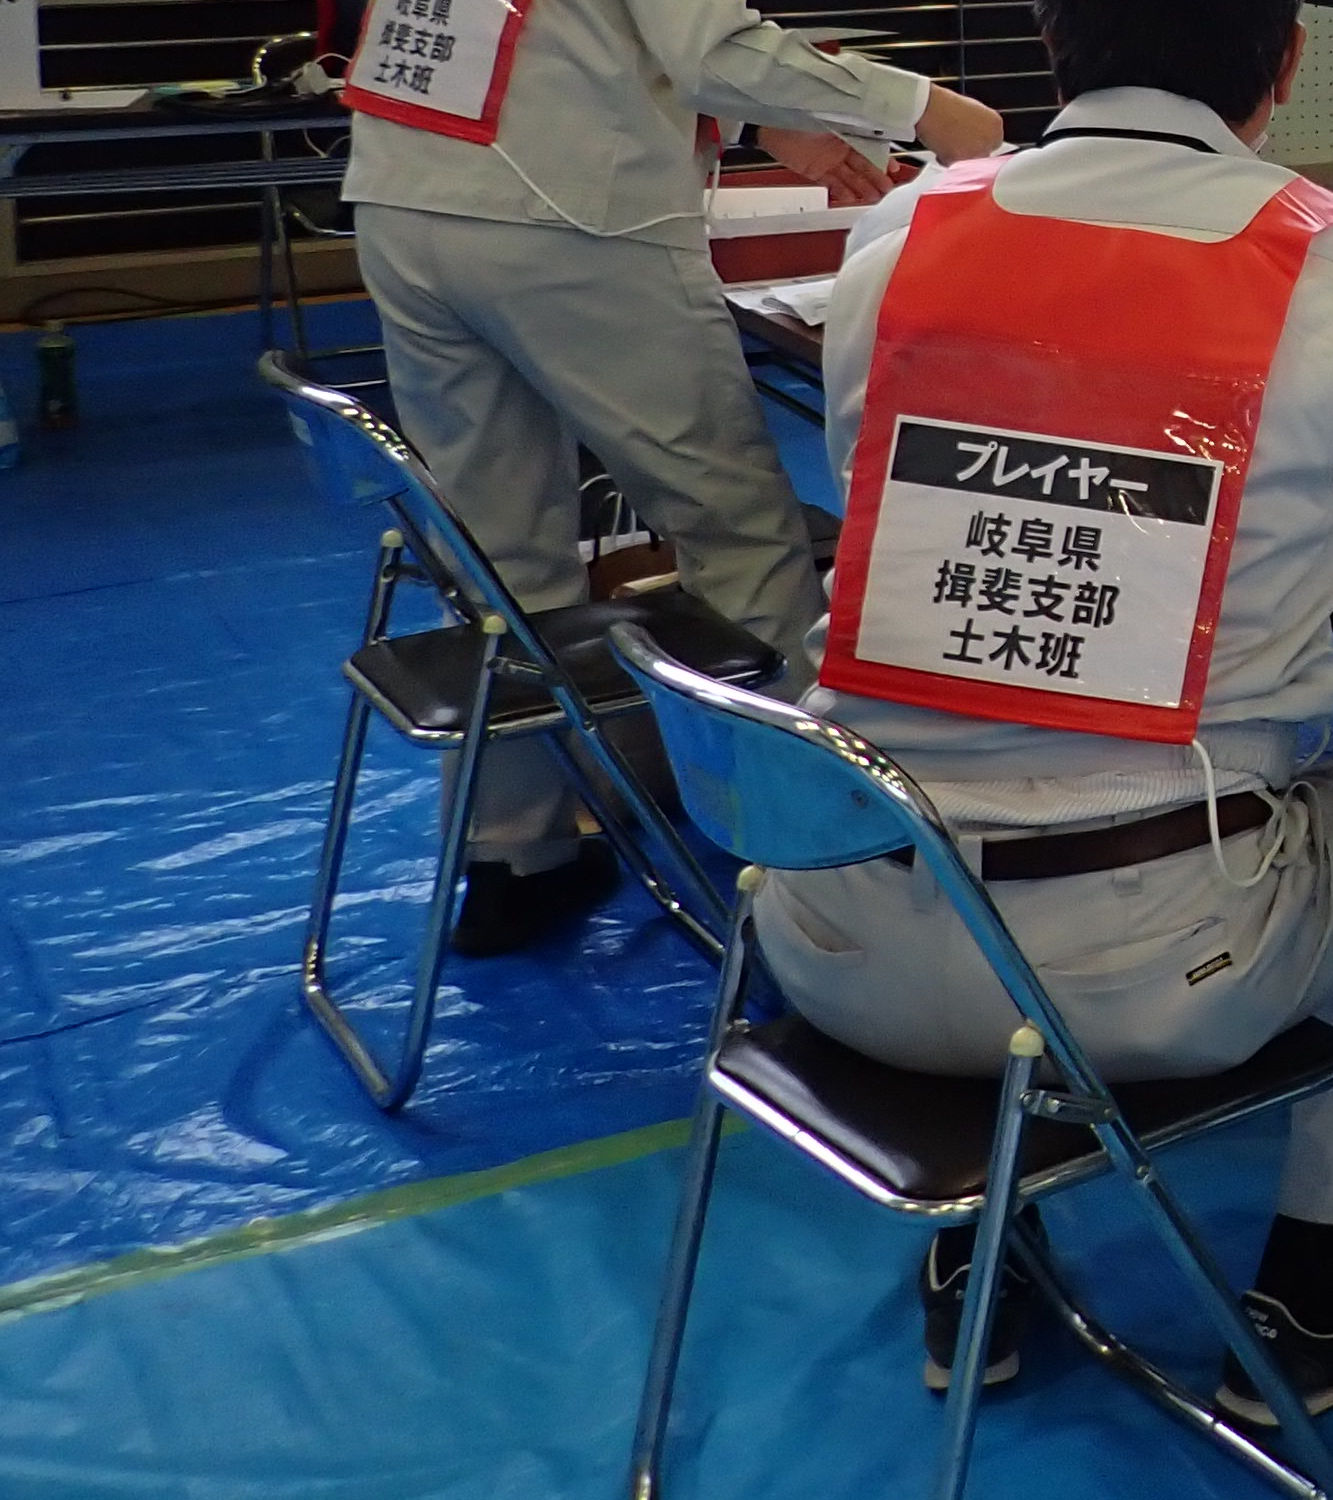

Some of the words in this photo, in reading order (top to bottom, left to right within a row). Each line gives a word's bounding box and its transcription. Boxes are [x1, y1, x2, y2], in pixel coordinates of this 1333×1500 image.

[373, 56, 436, 96] 土木班
[956, 440, 1149, 500] プレイヤー
[966, 510, 1102, 572] 岐阜県
[932, 559, 1121, 629] 揖斐支部
[942, 618, 1086, 679] 土木班
